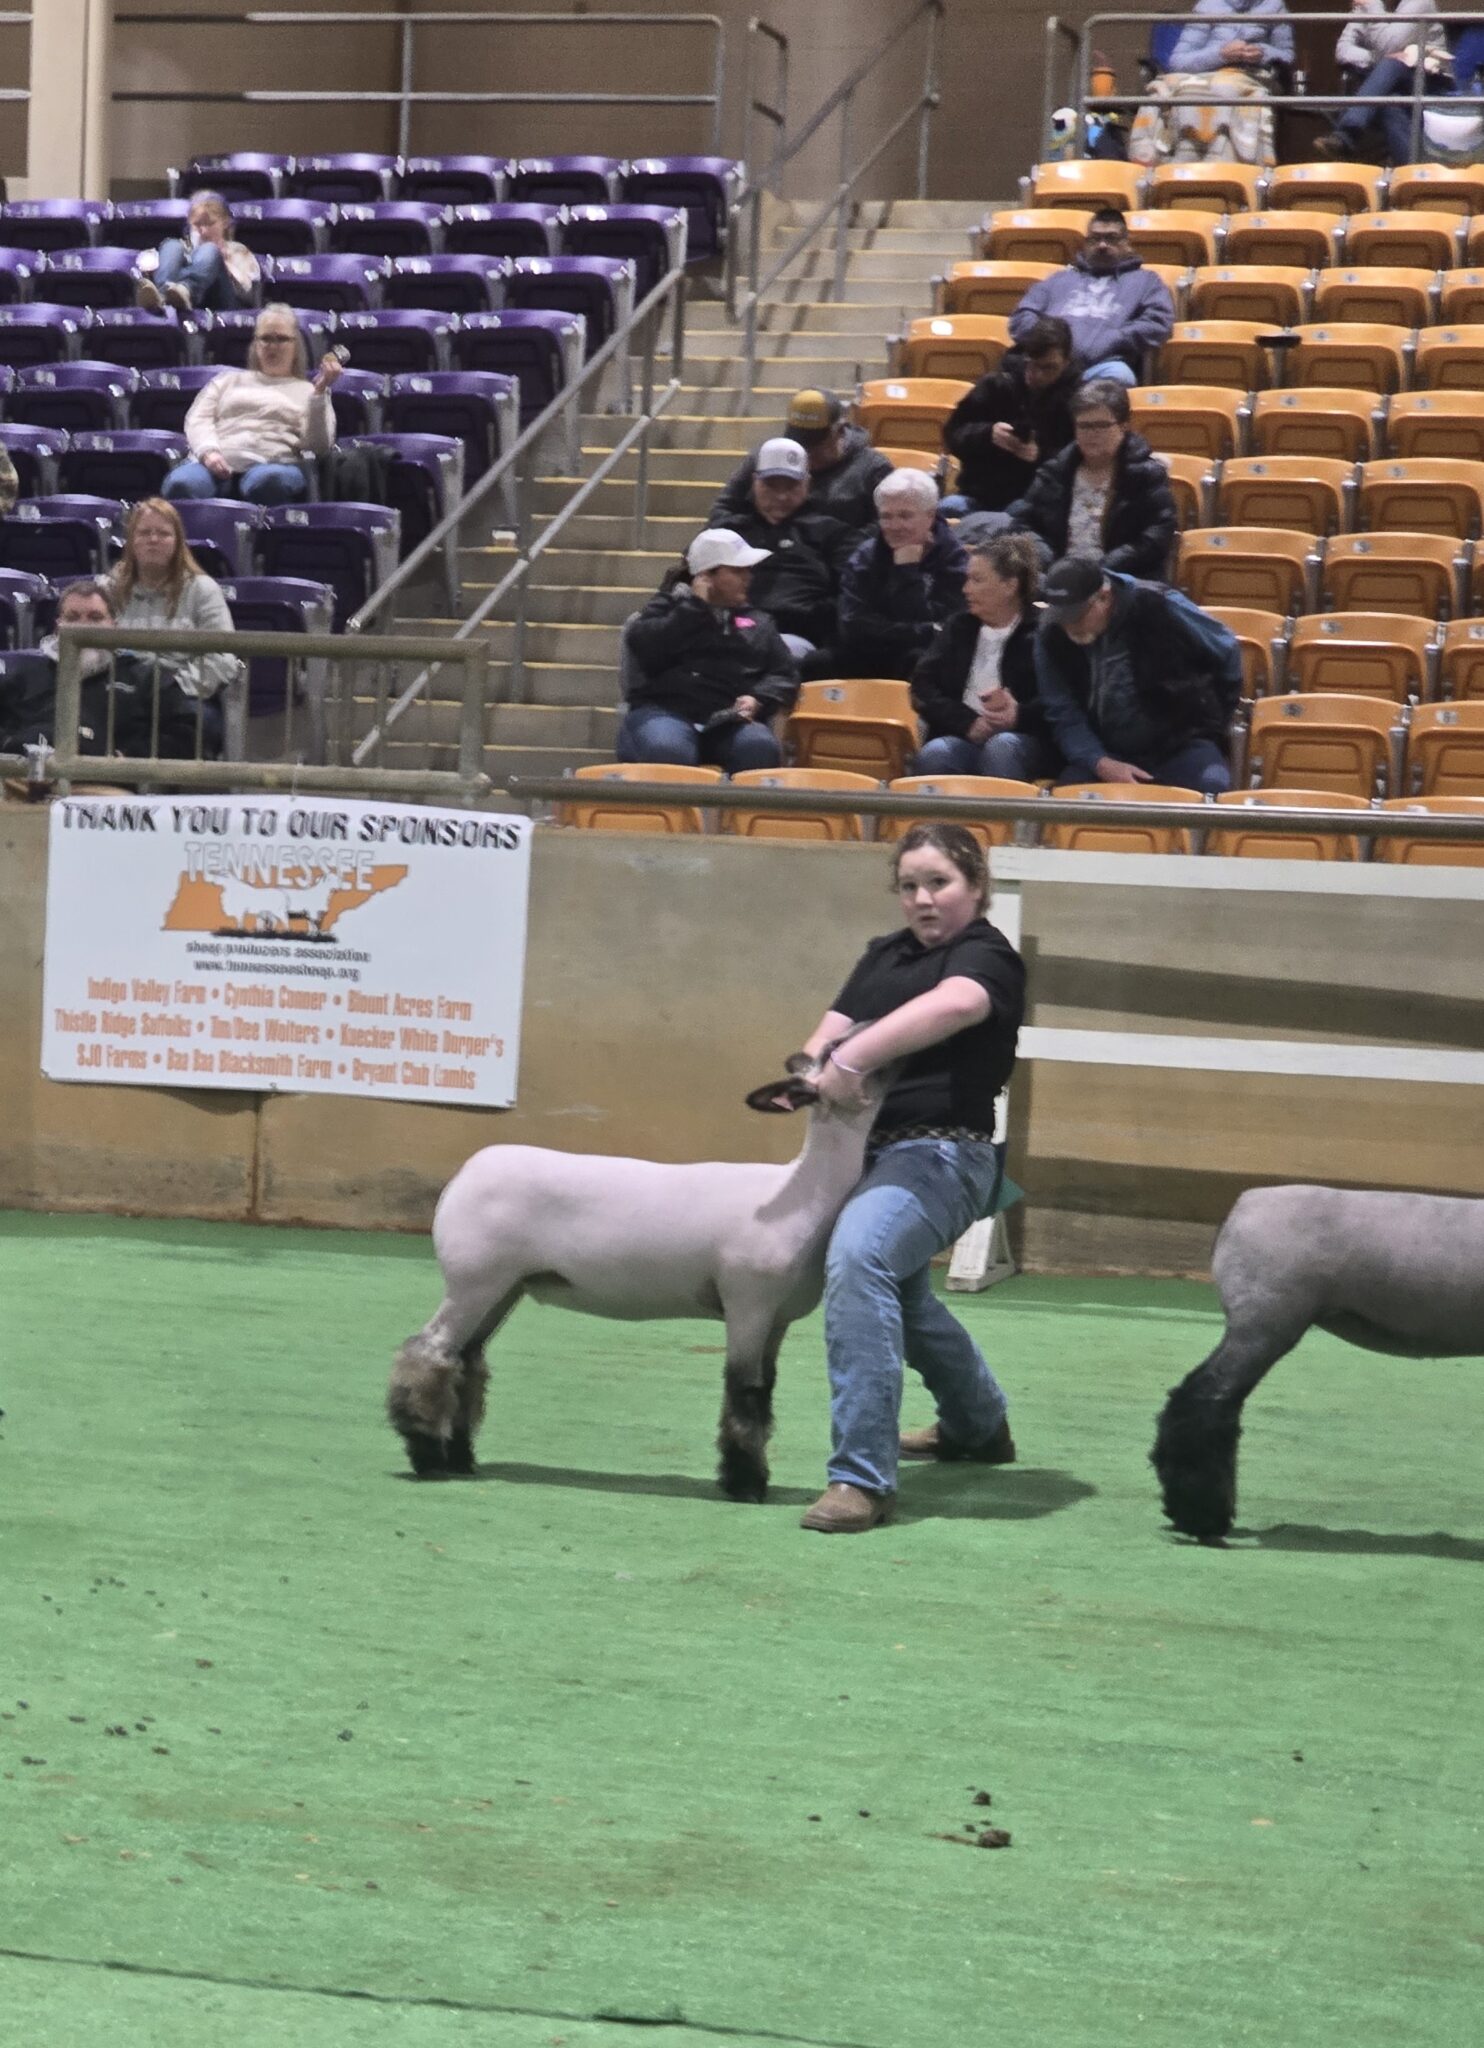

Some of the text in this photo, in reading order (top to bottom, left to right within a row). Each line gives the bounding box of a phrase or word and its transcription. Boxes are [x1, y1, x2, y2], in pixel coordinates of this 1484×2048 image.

[62, 802, 521, 850] THANK YOU TO OUR SPONSORS
[185, 841, 375, 892] TENNESSEE
[88, 977, 126, 1003] Indigo
[132, 978, 170, 1006] Valley
[175, 980, 206, 1004] Farm
[225, 982, 273, 1008] Cynthia
[347, 989, 388, 1015] Blount
[394, 993, 432, 1018] Acres
[438, 995, 471, 1021] Farm
[55, 1008, 96, 1033] Thistle
[101, 1011, 136, 1038] Ridge
[400, 1026, 438, 1052] White
[443, 1030, 504, 1059] Dorper's
[107, 1045, 147, 1069] Farms
[219, 1050, 292, 1077] Blacksmith
[298, 1054, 332, 1080] Farm
[352, 1058, 397, 1086] Bryant
[434, 1063, 476, 1090] Lambs
